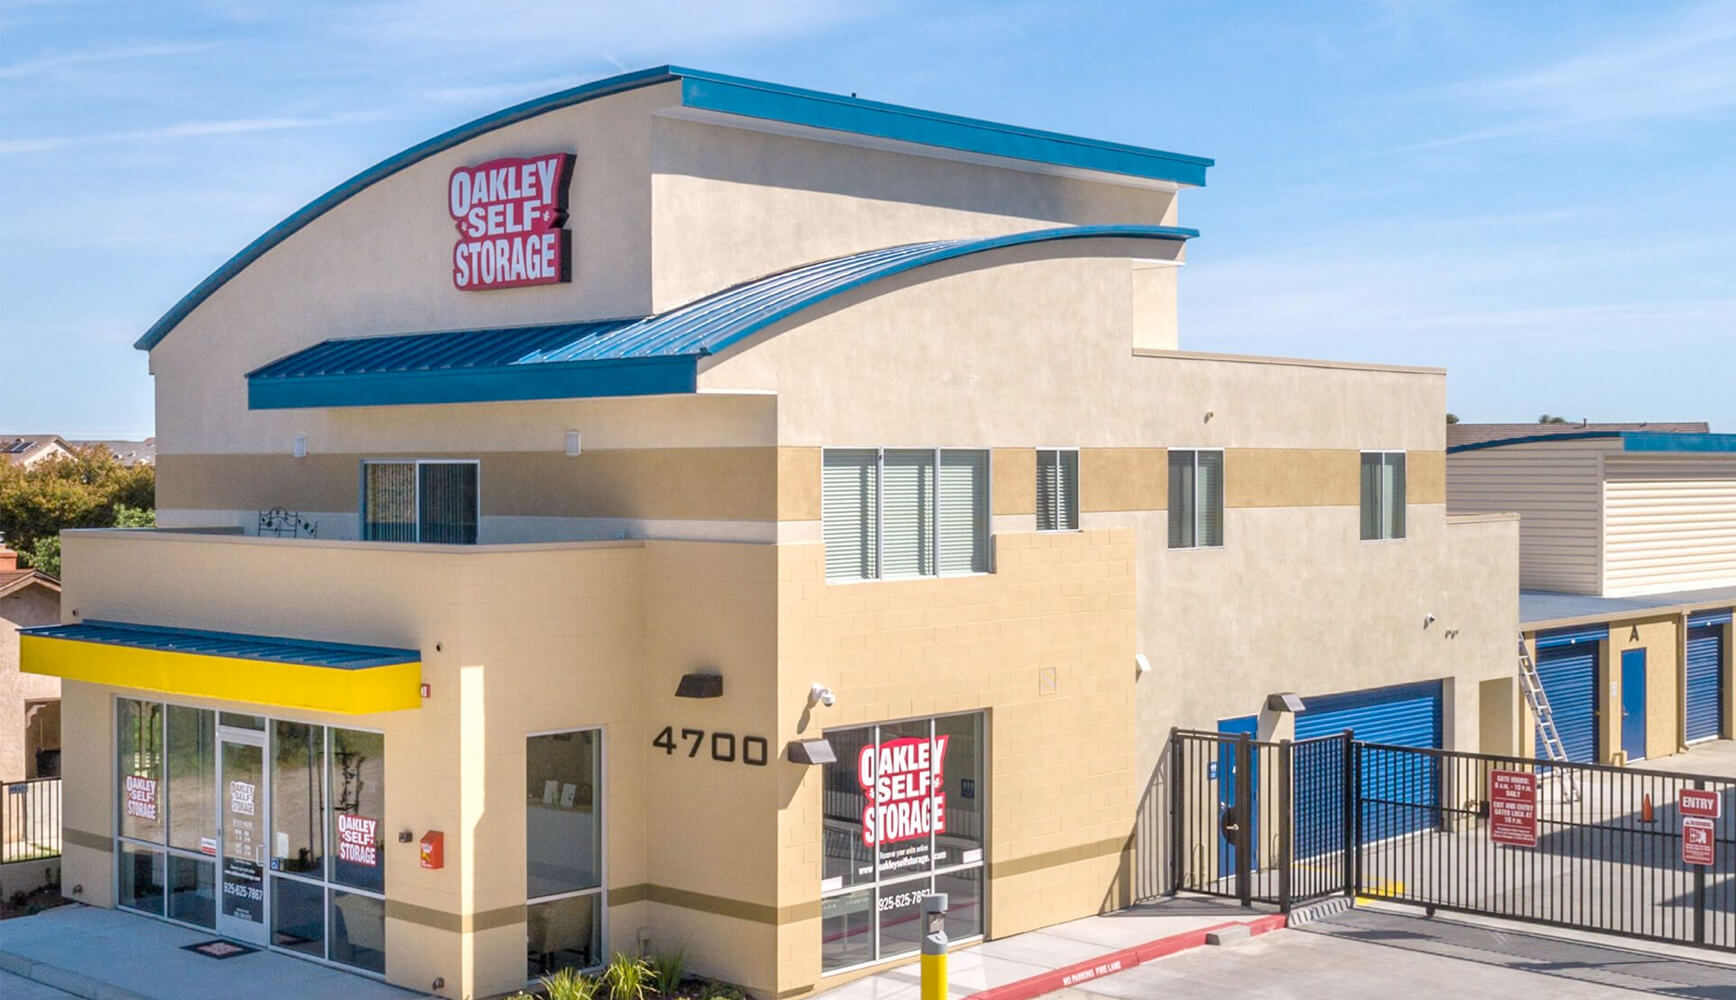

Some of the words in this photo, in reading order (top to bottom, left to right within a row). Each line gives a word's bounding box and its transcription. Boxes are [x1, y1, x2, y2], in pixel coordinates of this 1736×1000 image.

[451, 159, 557, 217] OAKLEY
[468, 200, 541, 238] SELF
[456, 233, 555, 287] STORAGE
[1629, 623, 1639, 642] A
[652, 726, 768, 766] 4700
[861, 739, 945, 786] OAKLEY
[126, 776, 157, 795] OAKLEY
[131, 789, 153, 803] SELF
[878, 771, 931, 802] SELF
[127, 801, 156, 820] STORAGE
[1494, 808, 1510, 816] GATES
[1505, 802, 1516, 810] AND
[1517, 803, 1533, 811] ENTRY
[1682, 796, 1714, 810] ENTRY
[338, 814, 376, 836] OAKLEY
[865, 796, 944, 843] STORAGE
[345, 831, 370, 844] SELF
[340, 843, 376, 865] STORAGE
